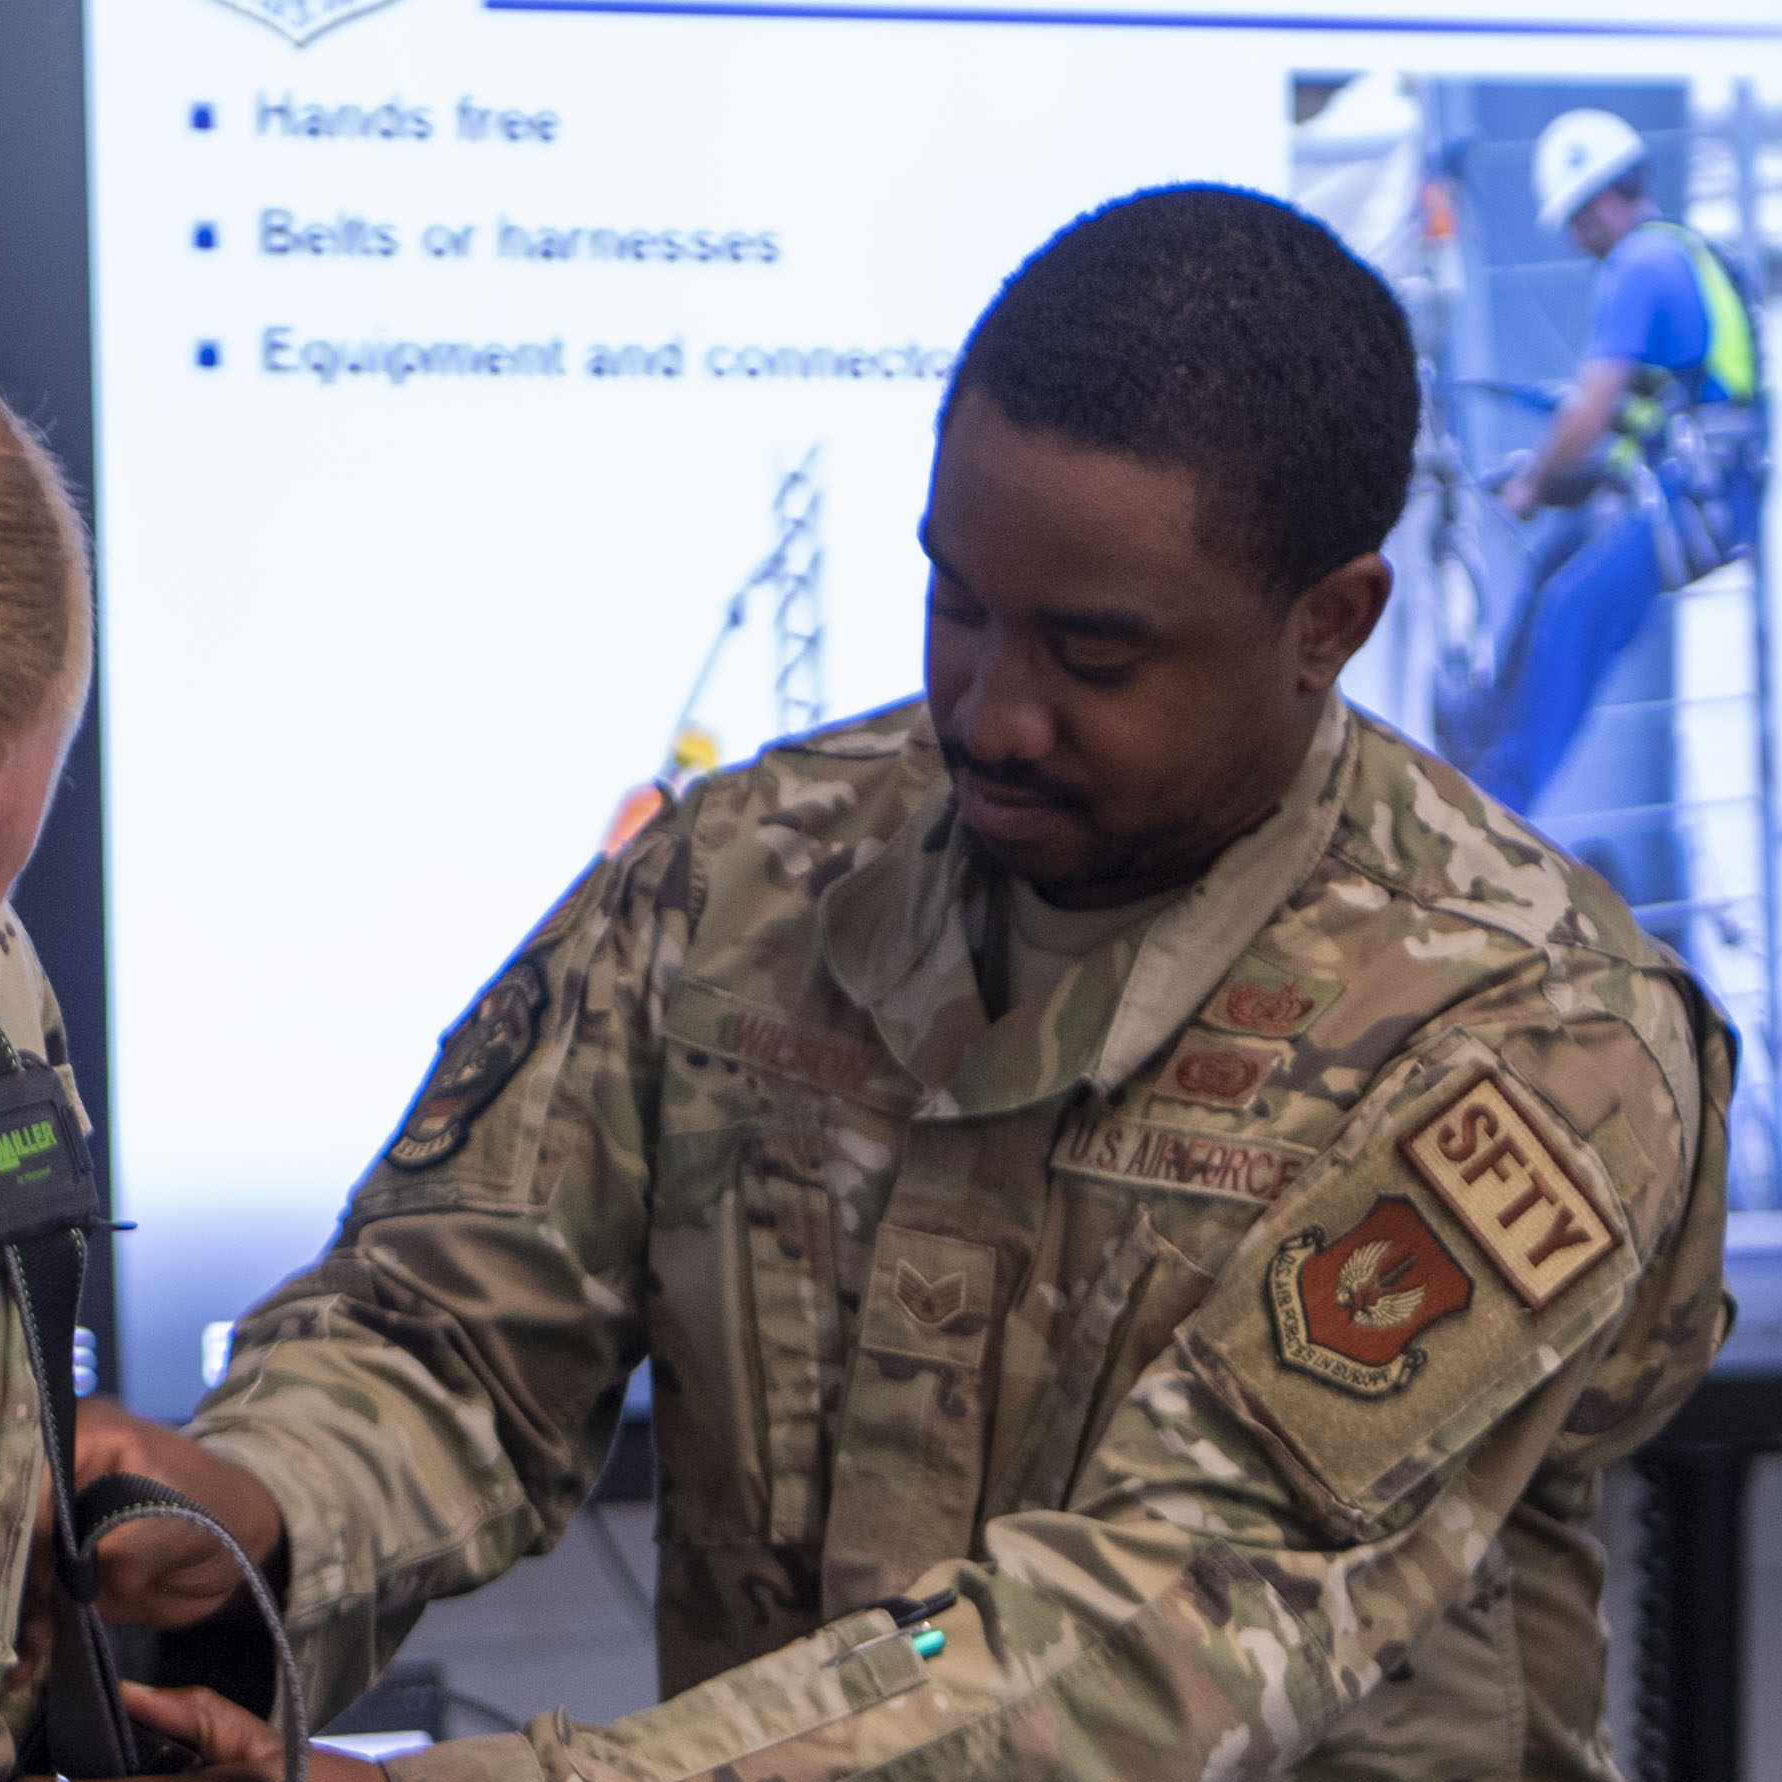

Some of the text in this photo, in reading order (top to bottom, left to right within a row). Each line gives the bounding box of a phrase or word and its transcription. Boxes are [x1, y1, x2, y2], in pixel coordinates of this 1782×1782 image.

[255, 92, 561, 143] Hands free
[258, 208, 782, 267] Belts or harnesses
[260, 327, 958, 387] Equipment and connecto
[1126, 1127, 1179, 1182] AIR
[1180, 1136, 1304, 1199] FORCE
[1437, 1102, 1592, 1268] SFTY
[1274, 1280, 1293, 1307] AIR
[1281, 1307, 1315, 1362] FORCES
[1315, 1353, 1331, 1370] IN
